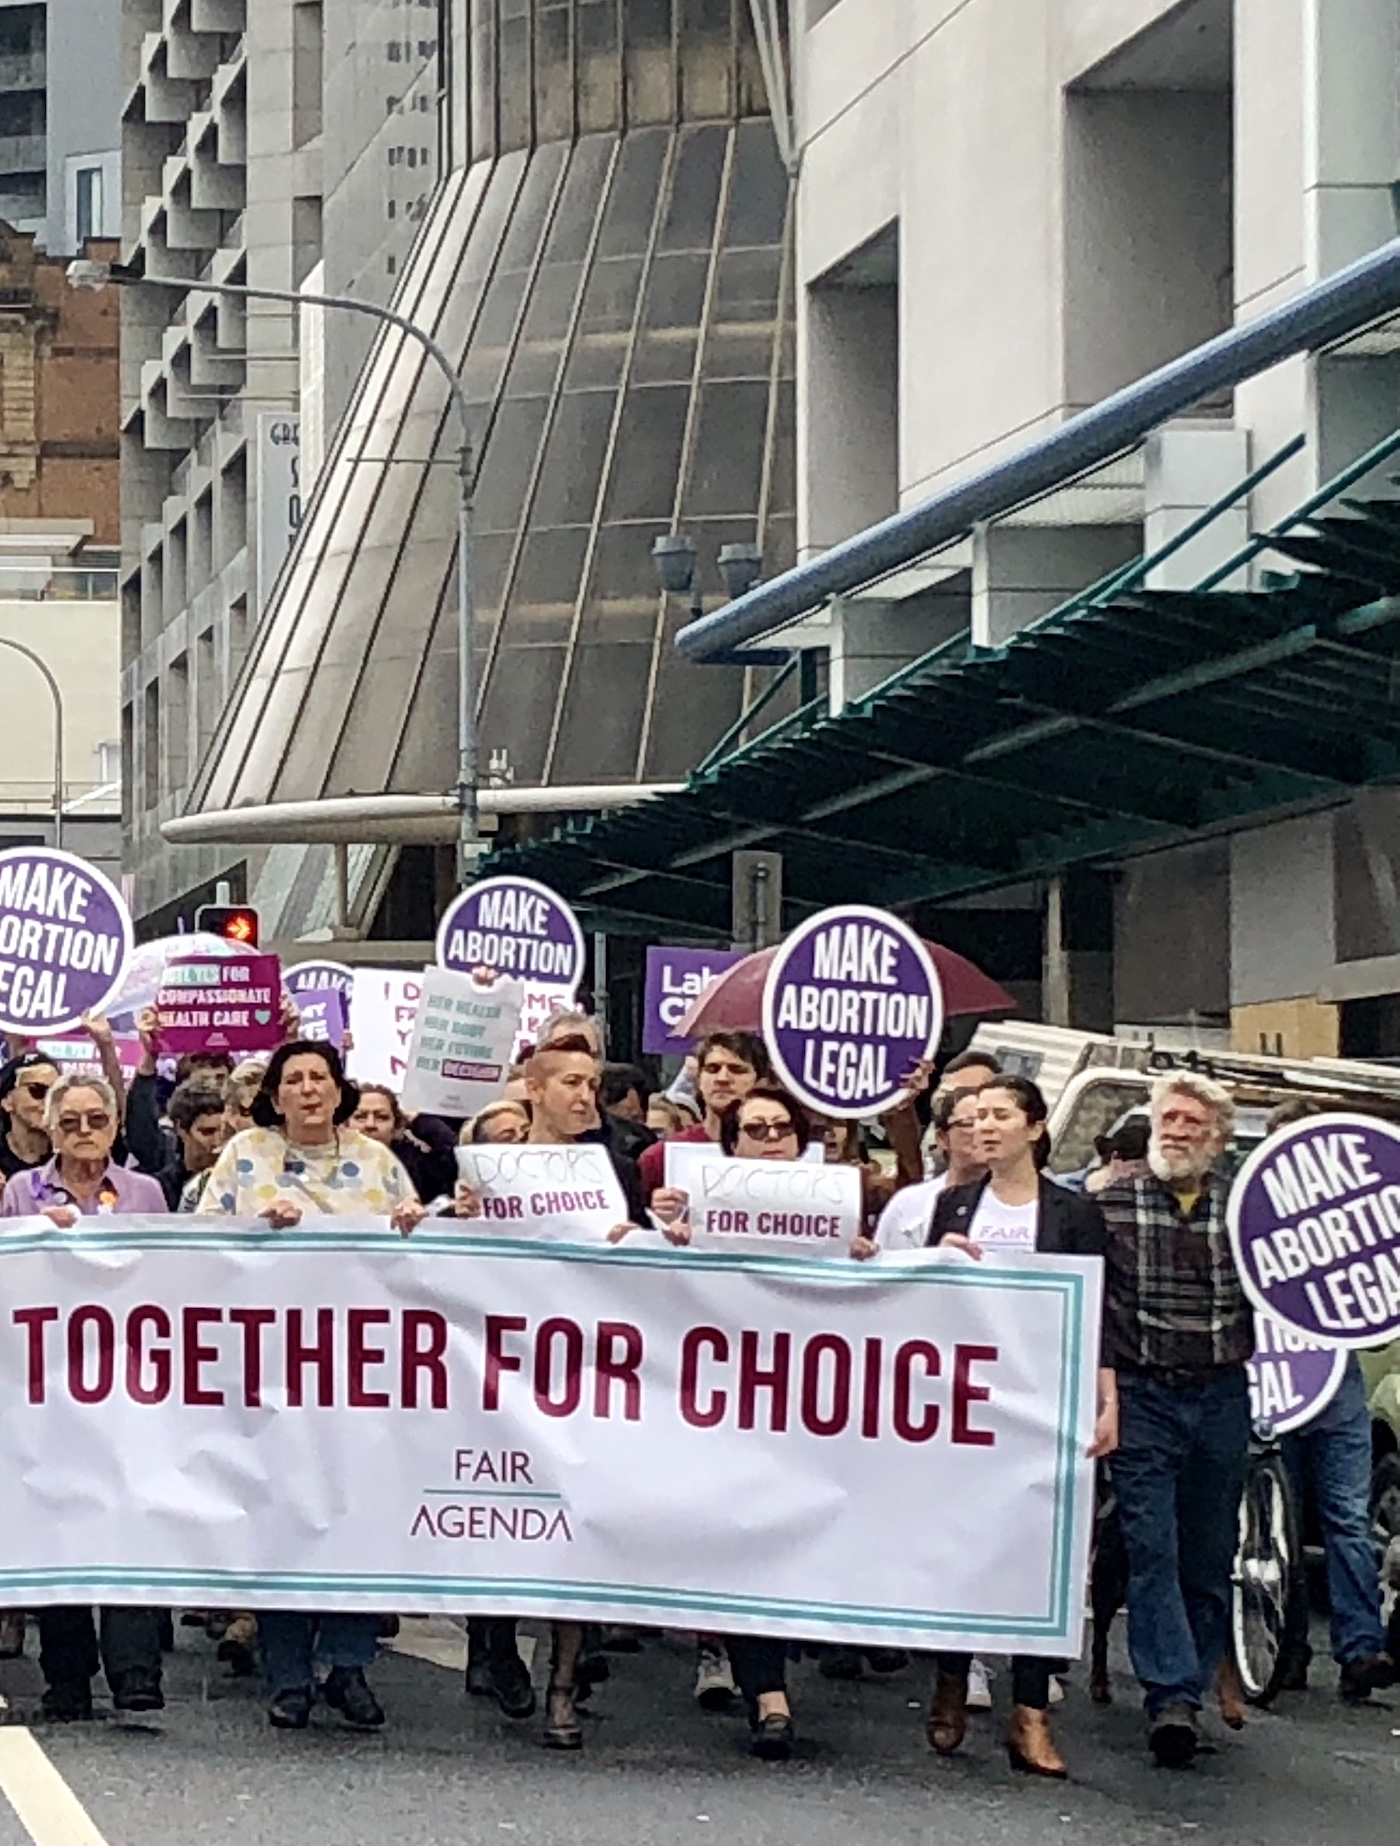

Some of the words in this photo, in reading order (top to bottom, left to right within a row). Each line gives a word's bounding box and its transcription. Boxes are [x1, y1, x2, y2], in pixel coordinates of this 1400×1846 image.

[477, 889, 550, 936] MAKE
[448, 929, 573, 976] ABORTION
[813, 923, 900, 985] MAKE
[223, 965, 250, 982] FOR
[157, 988, 271, 1006] COMPASSIONATE
[777, 984, 929, 1040] ABORTION
[212, 1010, 249, 1027] CARE
[803, 1039, 893, 1100] LEGAL
[474, 1148, 602, 1184] DOCTORS
[702, 1163, 848, 1205] DOCTORS
[1261, 1132, 1383, 1219] MAKE
[483, 1195, 524, 1220] FOR
[530, 1189, 610, 1216] CHOICE
[706, 1210, 749, 1233] FOR
[757, 1212, 841, 1238] CHOICE
[13, 1304, 448, 1411] TOGETHER
[483, 1315, 644, 1422] FOR
[680, 1325, 998, 1446] CHOICE
[455, 1449, 534, 1485] FAIR
[409, 1504, 573, 1542] AGENDA
